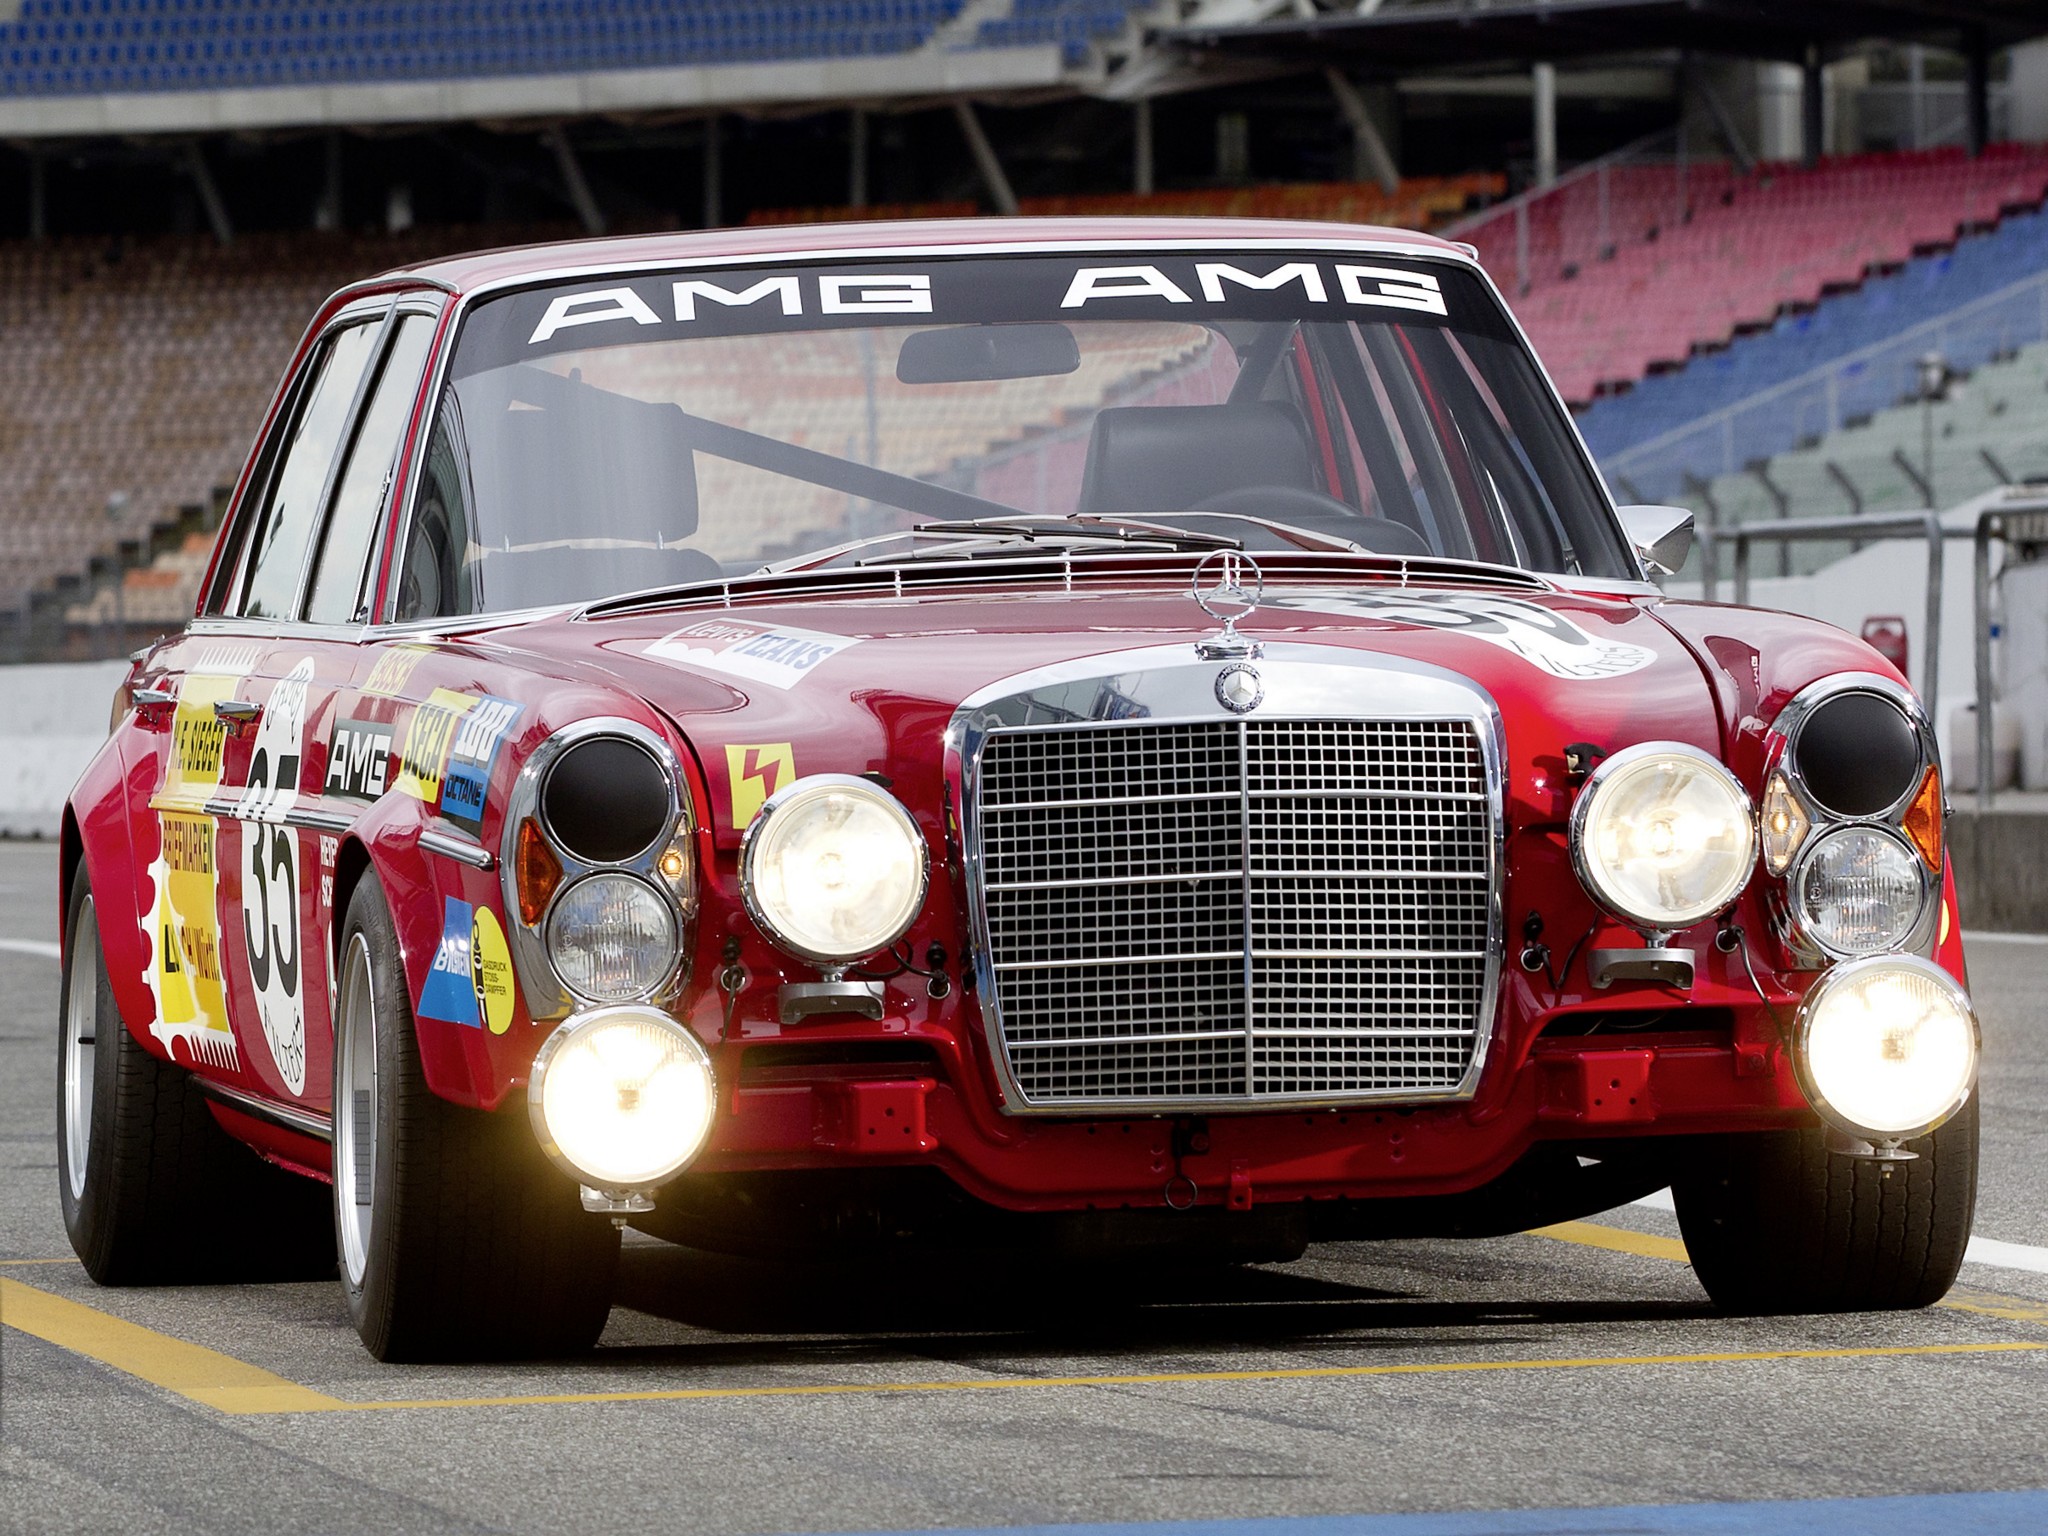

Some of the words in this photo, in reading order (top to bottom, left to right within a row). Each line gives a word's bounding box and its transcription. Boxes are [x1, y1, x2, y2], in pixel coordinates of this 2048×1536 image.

[528, 274, 934, 344] AMG
[1060, 262, 1448, 315] AMG
[1240, 590, 1590, 646] 35
[733, 633, 835, 670] JEANS
[188, 719, 224, 771] SIEGER
[325, 729, 392, 796] AMG
[444, 773, 484, 808] OCTANE
[245, 747, 300, 998] 35
